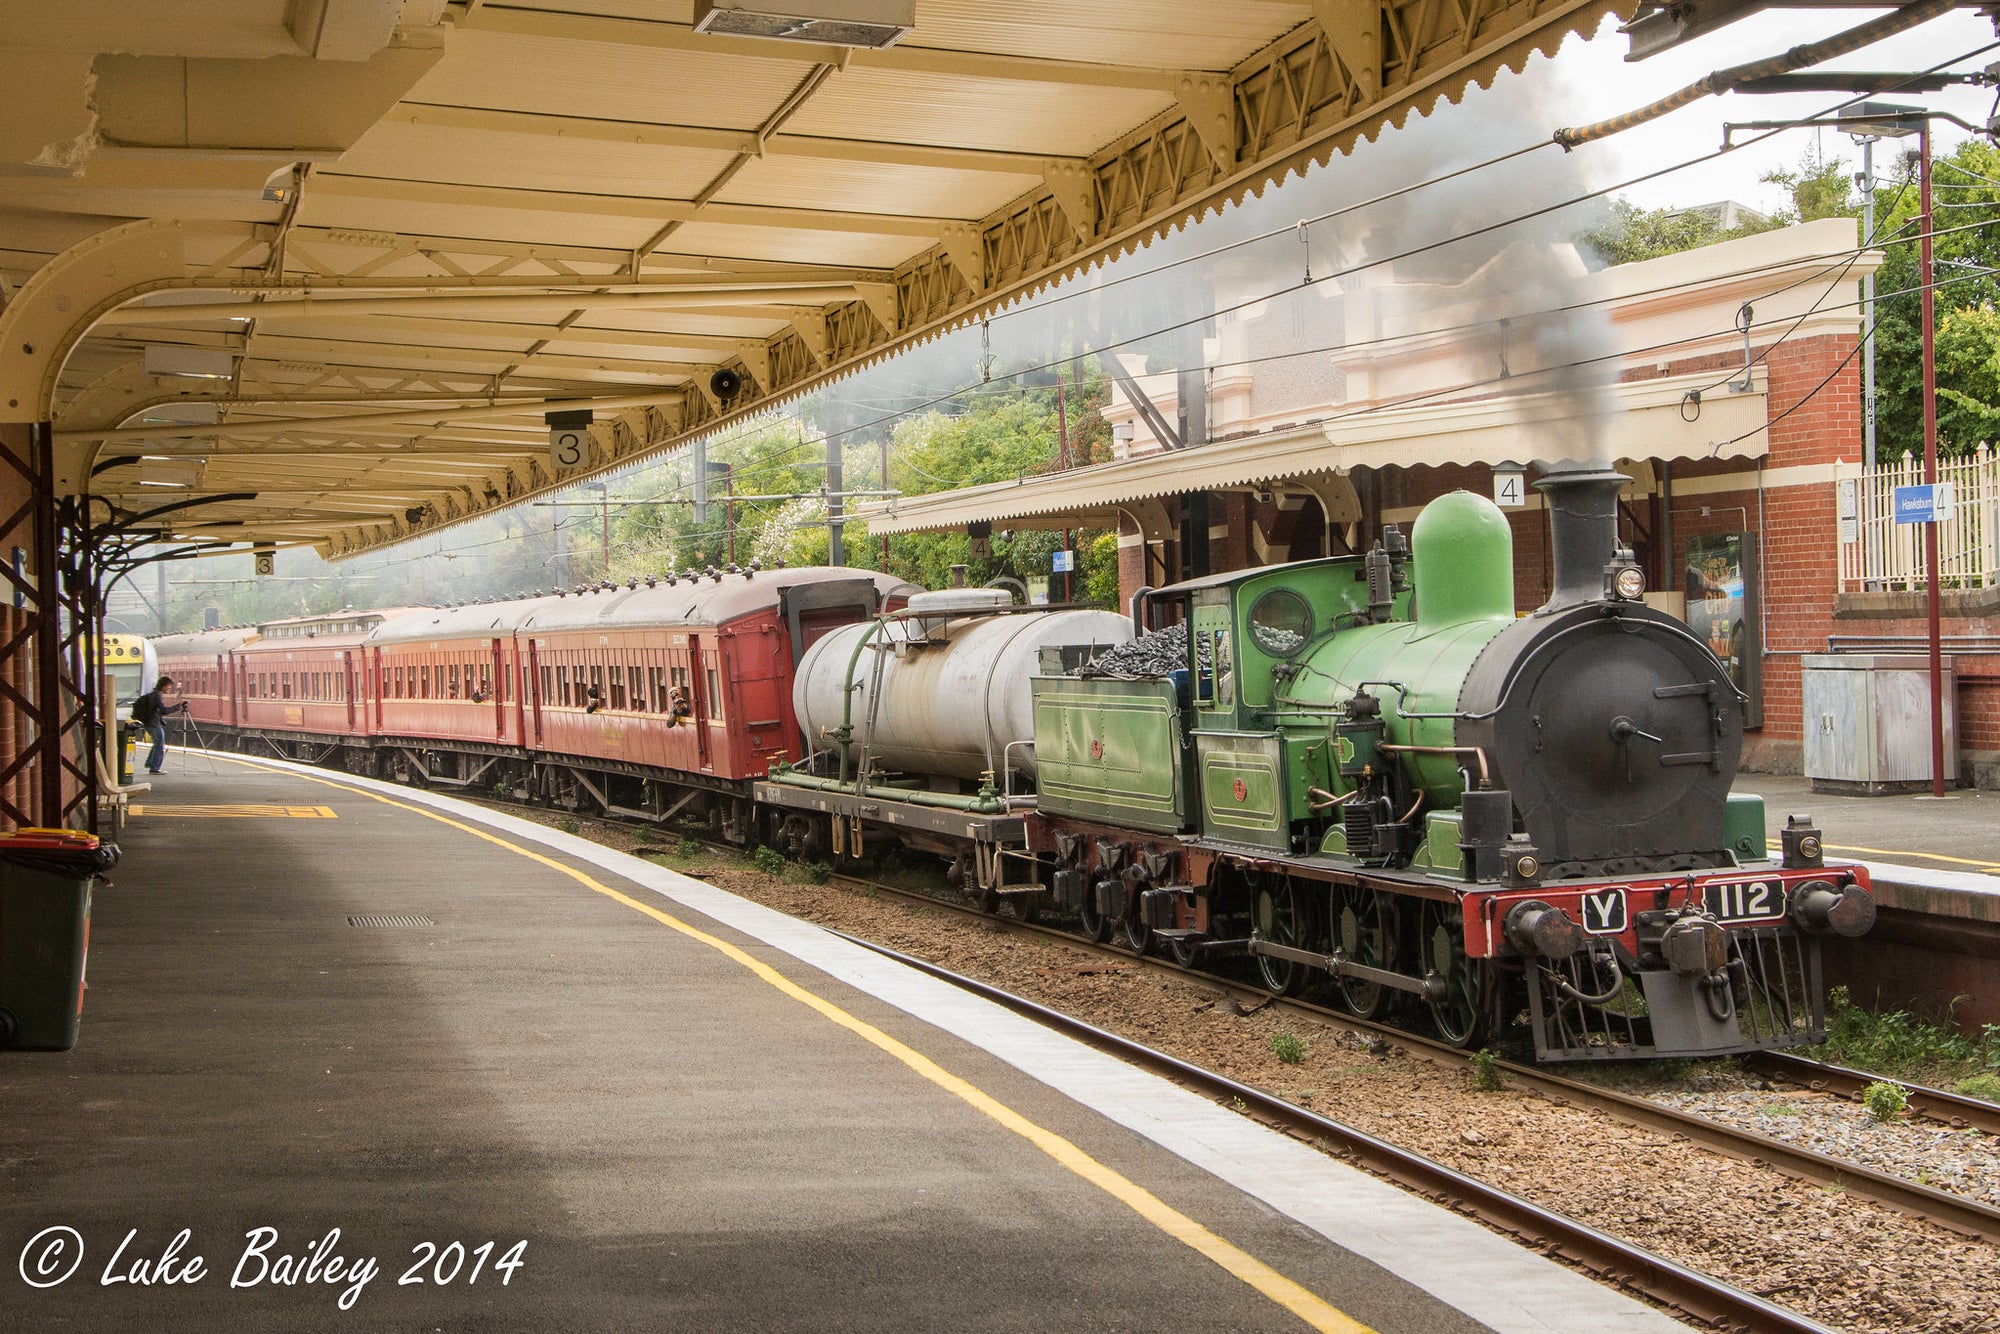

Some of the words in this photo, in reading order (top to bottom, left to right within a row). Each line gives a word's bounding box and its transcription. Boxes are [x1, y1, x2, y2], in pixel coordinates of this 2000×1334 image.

[558, 433, 580, 465] 3
[1501, 478, 1518, 503] 4
[1901, 496, 1933, 511] Hawksburn
[1936, 488, 1946, 516] 4
[975, 540, 987, 557] 4
[259, 558, 271, 574] 3
[1590, 893, 1616, 927] Y
[1720, 881, 1771, 917] 112
